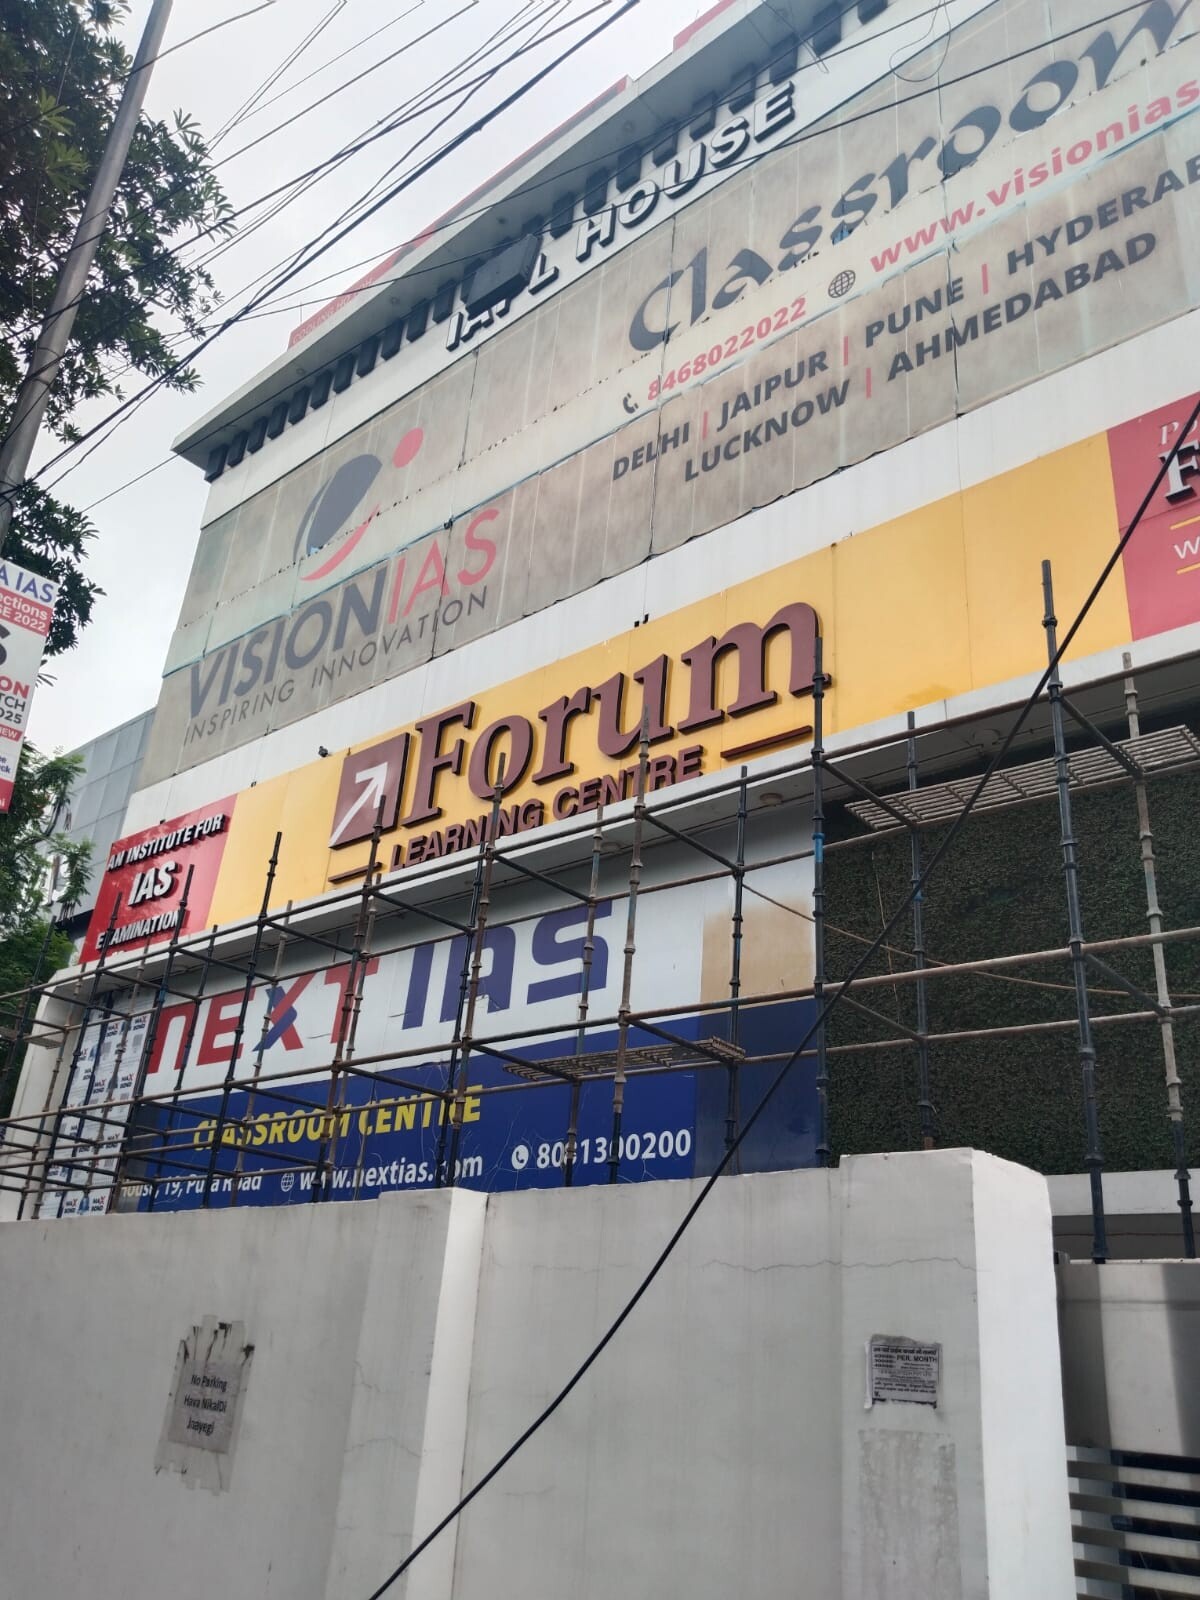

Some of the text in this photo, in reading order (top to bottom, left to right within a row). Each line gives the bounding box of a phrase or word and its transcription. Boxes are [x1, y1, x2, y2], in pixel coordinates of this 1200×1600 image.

[446, 253, 559, 352] IL
[576, 81, 795, 261] HOUSE
[648, 80, 1200, 400] 8468022022 www.visionias
[613, 422, 690, 480] DELHI
[717, 351, 828, 432] JAIPUR
[865, 276, 965, 348] PUNE
[685, 232, 1157, 482] LUCKNOW AHMEDABAD
[14, 612, 46, 633] 2022
[16, 571, 54, 603] IAS
[183, 586, 488, 746] INSPIRING INNOVATION
[401, 601, 832, 827] Forum
[107, 813, 227, 872] AN INSTITUTE FOR
[390, 744, 704, 872] LEARNING CENTRE
[95, 908, 182, 950] EAMINATION
[127, 860, 178, 908] IAS
[402, 900, 613, 1031] IAS
[186, 1174, 220, 1194] Pua
[222, 1168, 262, 1192] Rad
[191, 1374, 227, 1393] No Parking
